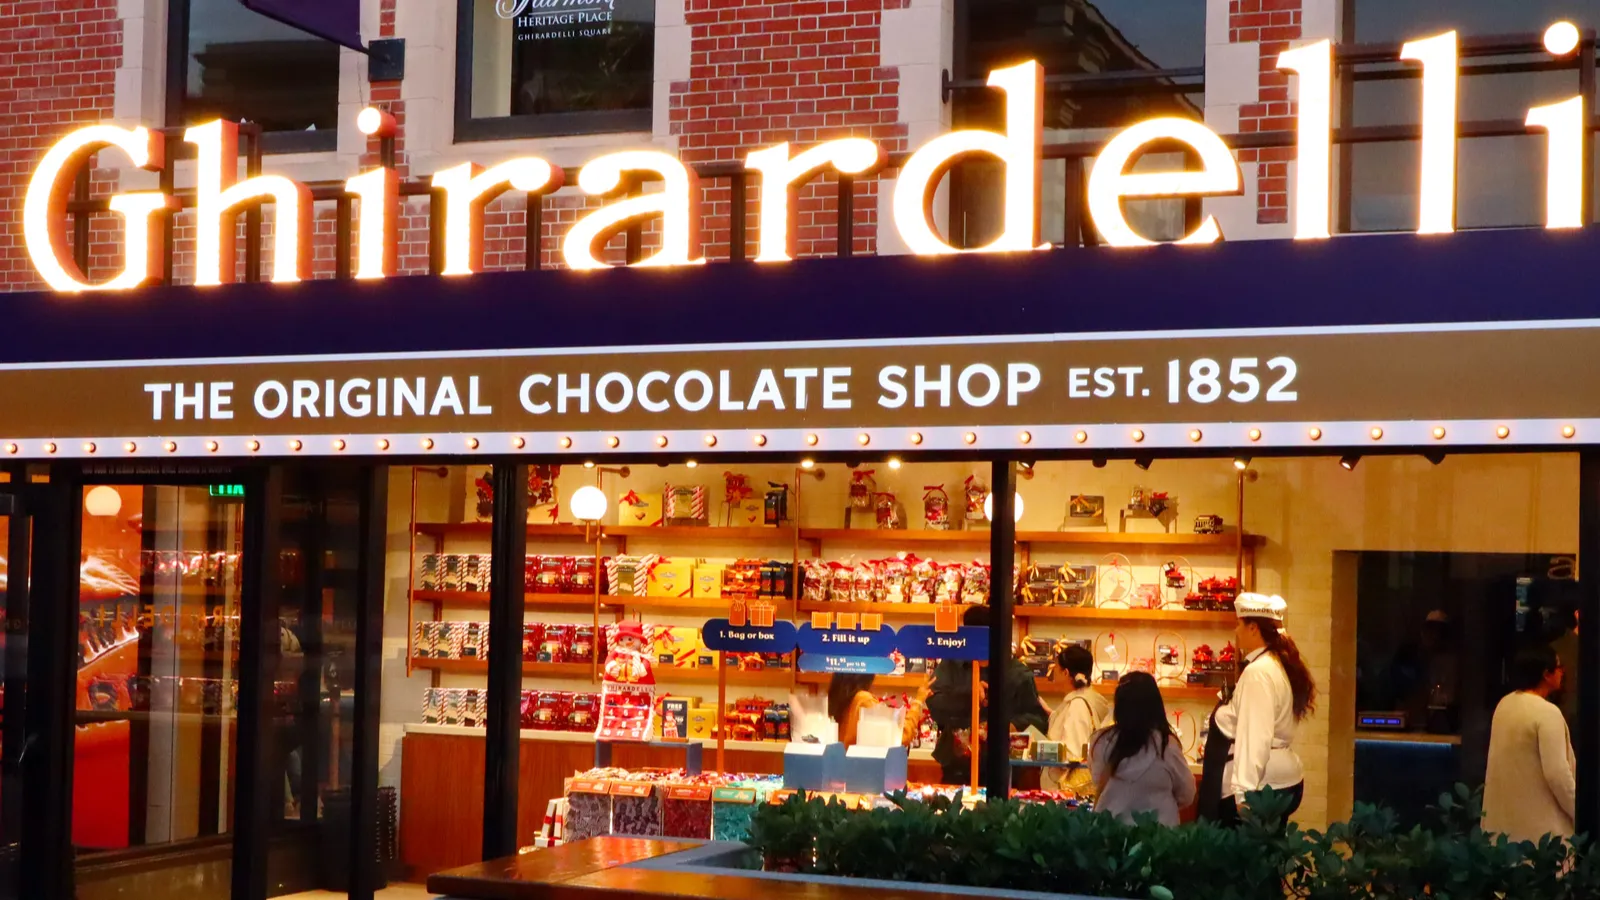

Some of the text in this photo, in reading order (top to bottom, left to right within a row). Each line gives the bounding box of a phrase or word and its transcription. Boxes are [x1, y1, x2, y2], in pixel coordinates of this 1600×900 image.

[518, 11, 612, 27] HERITAGE PLACE
[518, 28, 612, 40] GHIRARDELLI SQUARE
[23, 21, 1583, 292] Ghirardelli
[144, 356, 1298, 420] THE ORIGINAL CHOCOLATE SHOP EST. 1852
[719, 630, 726, 638] 1.
[728, 631, 745, 640] Bag
[758, 632, 775, 640] box
[822, 634, 870, 645] 2. Fill it up
[927, 637, 966, 648] 3. Enjoy!
